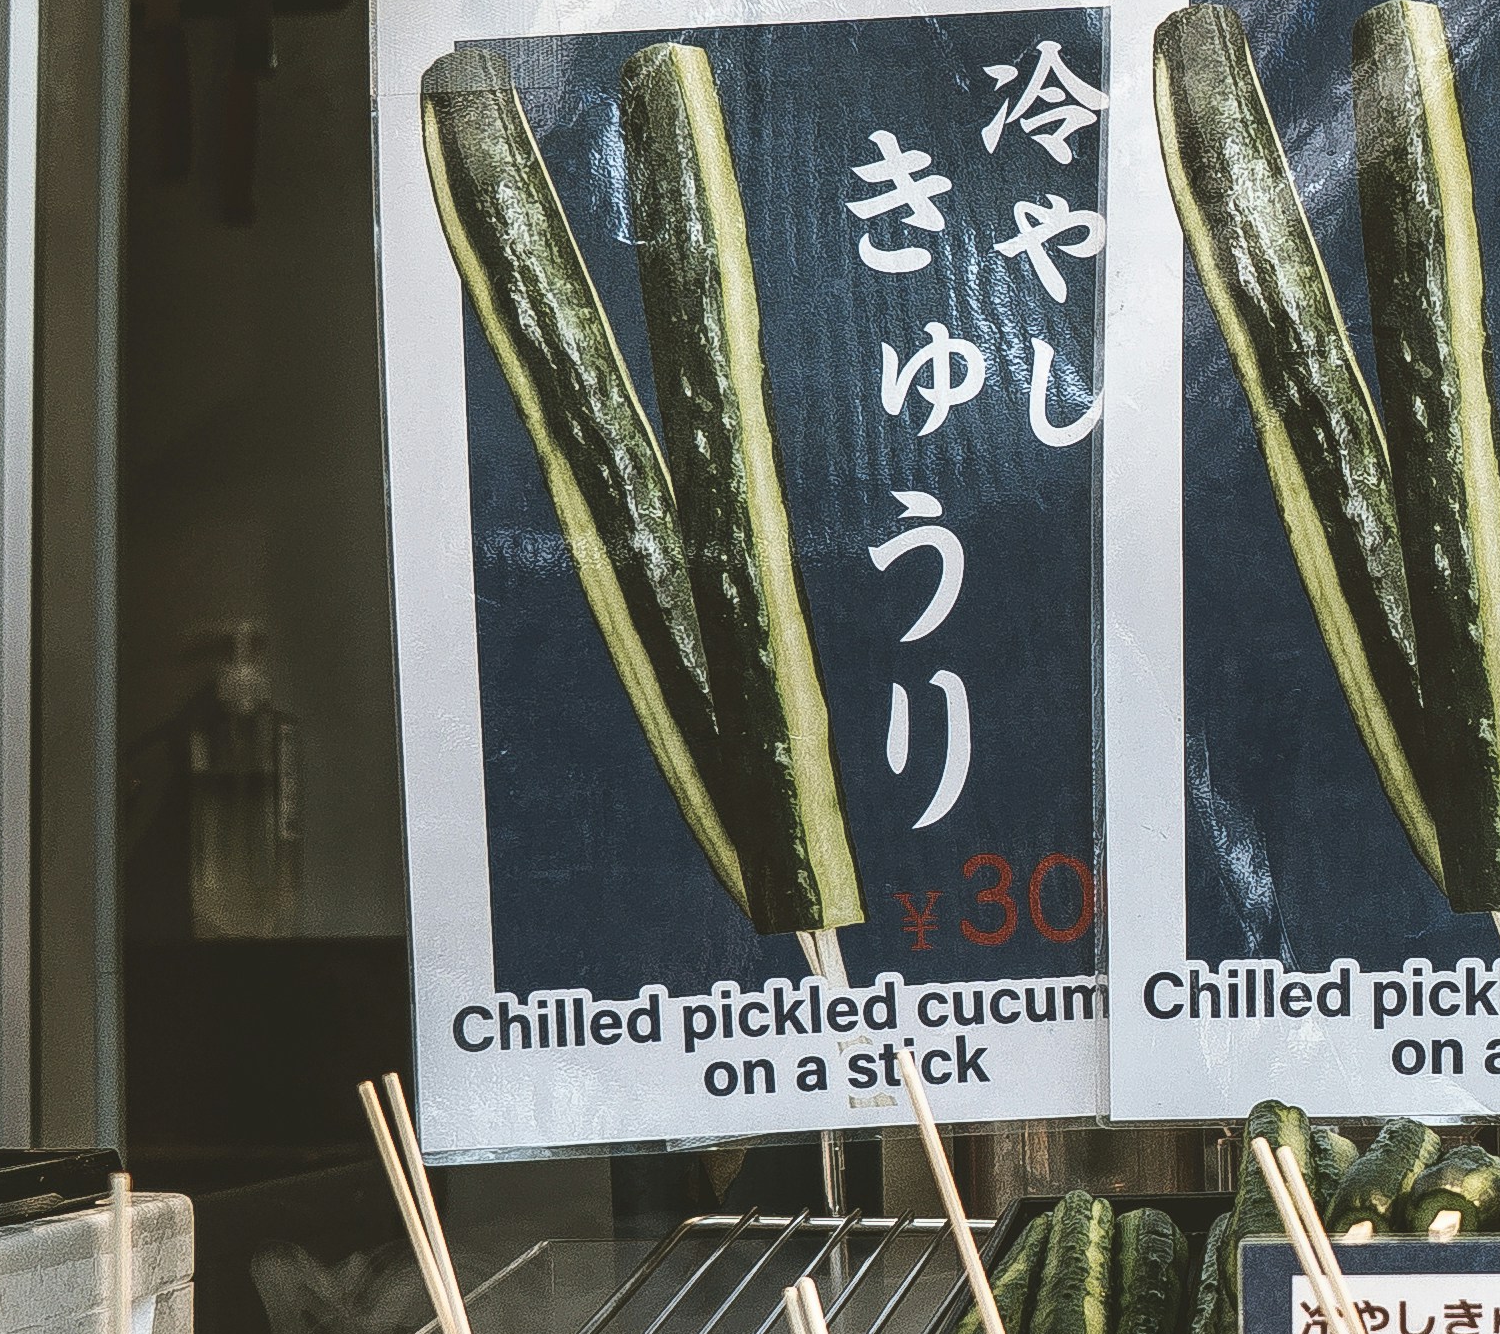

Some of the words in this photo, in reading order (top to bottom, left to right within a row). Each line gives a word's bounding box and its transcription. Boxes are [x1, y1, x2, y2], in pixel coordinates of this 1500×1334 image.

[981, 40, 1110, 448] 冷やし
[846, 129, 985, 830] きゅうり
[452, 989, 663, 1054] Chilled
[682, 977, 901, 1045] pickled
[1142, 967, 1351, 1020] Chilled
[702, 1050, 775, 1098] on
[794, 1051, 828, 1094] a
[1390, 1034, 1466, 1076] on
